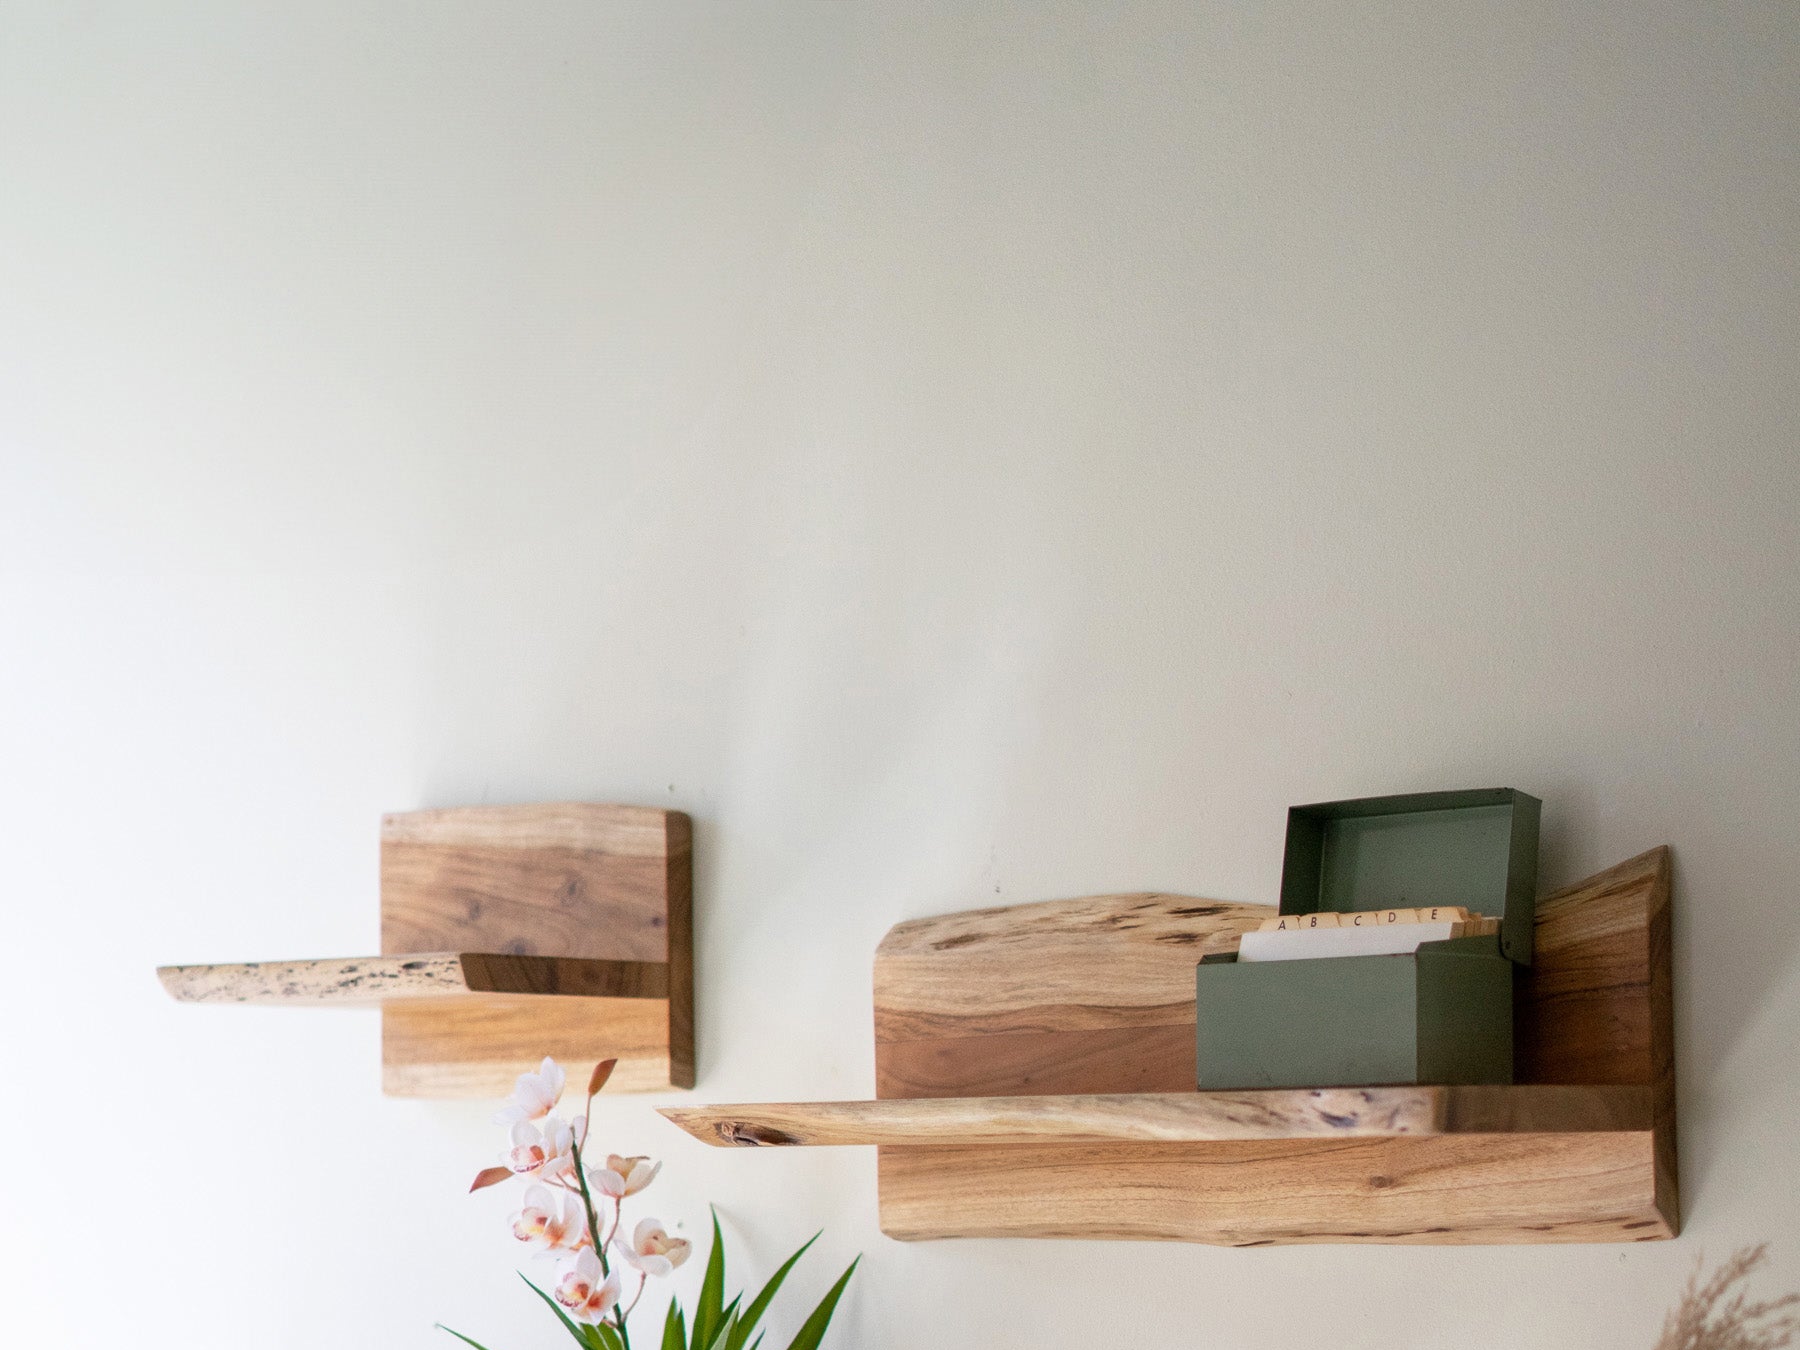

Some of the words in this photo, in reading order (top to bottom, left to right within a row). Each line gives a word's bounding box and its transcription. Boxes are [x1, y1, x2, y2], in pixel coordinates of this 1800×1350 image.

[1278, 919, 1286, 930] A
[1310, 917, 1317, 928] B
[1354, 915, 1362, 926] C
[1388, 912, 1396, 923] D
[1431, 908, 1438, 920] E
